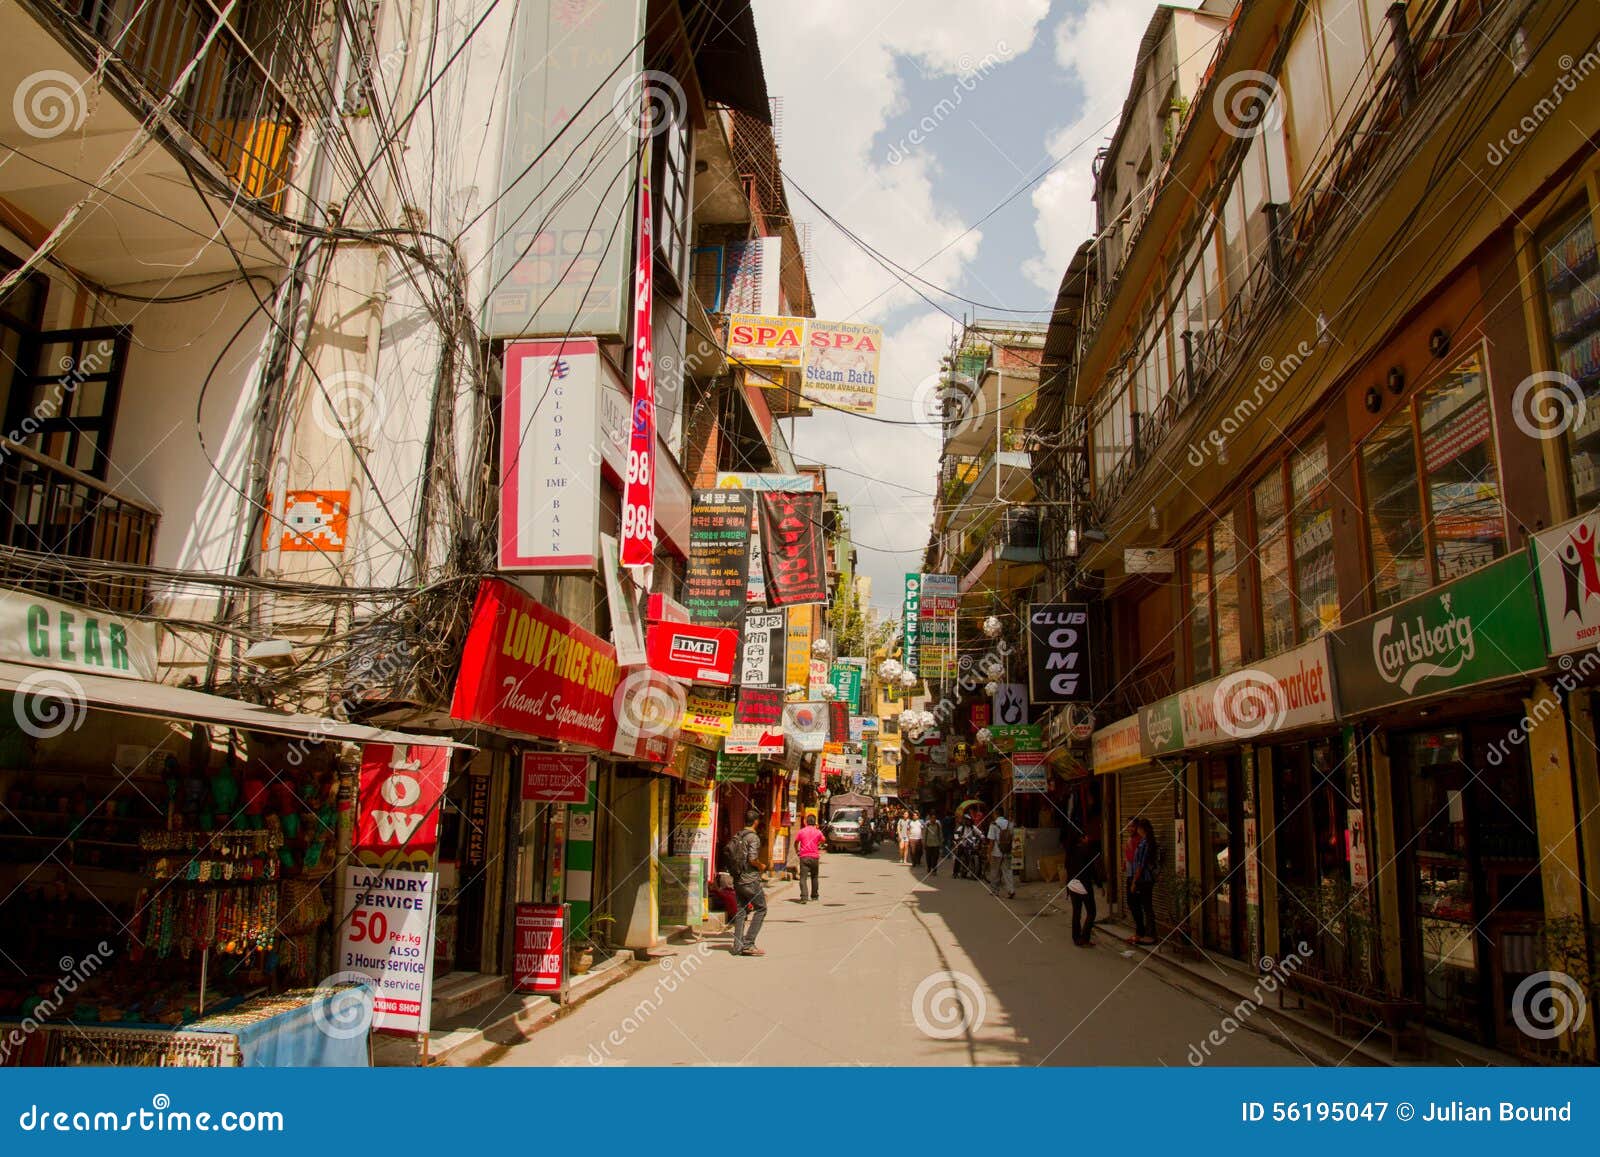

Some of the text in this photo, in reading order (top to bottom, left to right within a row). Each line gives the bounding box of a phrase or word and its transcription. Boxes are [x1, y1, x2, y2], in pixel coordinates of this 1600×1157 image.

[733, 326, 799, 346] SPA
[810, 332, 876, 352] SPA
[807, 366, 875, 385] Steam Bath
[837, 385, 874, 393] AVAILABLE
[546, 478, 568, 489] IME
[552, 499, 561, 552] BANK
[1032, 612, 1087, 624] CLUB
[27, 604, 129, 671] GEAR
[1576, 627, 1597, 640] SHOP
[502, 608, 548, 667] LOW
[545, 629, 590, 685] PRICE
[680, 640, 714, 653] IME
[1372, 610, 1475, 683] Carlsberg
[1045, 628, 1080, 695] OMG
[503, 676, 606, 732] Thamel Supermarket
[687, 706, 732, 717] CARGO
[691, 698, 728, 709] Loyal
[528, 773, 548, 786] MONEY
[371, 744, 424, 845] LOW
[470, 777, 485, 867] SUPERMARKET
[353, 874, 428, 892] LAUNDRY
[349, 910, 388, 944] 50
[524, 931, 553, 950] MONEY
[389, 946, 420, 957] ALSO
[347, 953, 424, 973] 3 Hours service
[516, 954, 560, 974] EXCHANGE
[384, 978, 421, 991] service
[398, 1003, 420, 1014] SHOP
